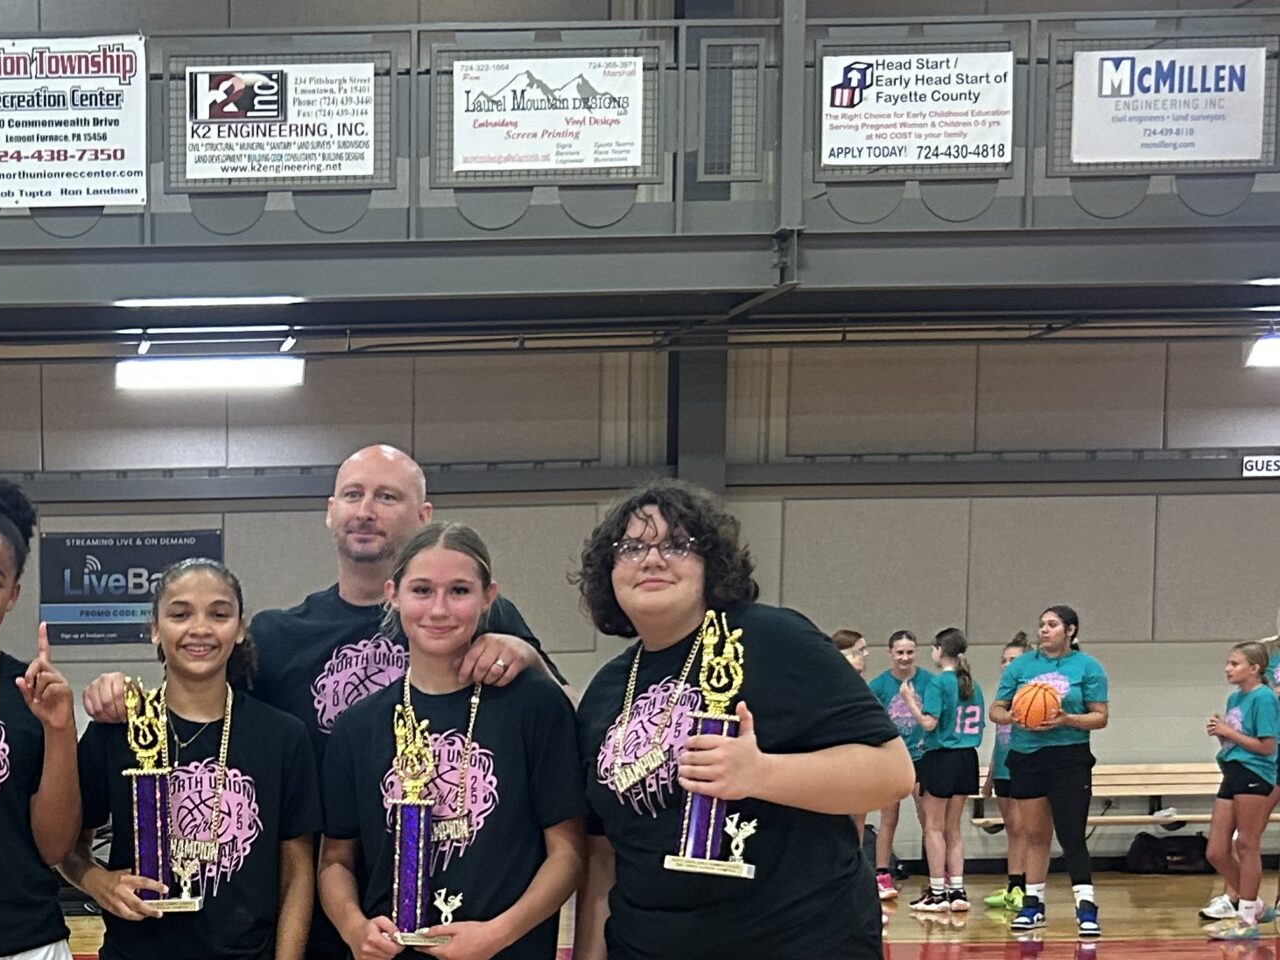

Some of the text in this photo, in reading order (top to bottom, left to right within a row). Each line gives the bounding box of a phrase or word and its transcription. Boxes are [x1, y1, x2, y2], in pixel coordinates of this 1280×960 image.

[33, 43, 136, 85] Township
[875, 57, 959, 71] Head Start /
[875, 71, 1009, 89] Early Head Start of
[70, 85, 124, 110] Center
[464, 89, 630, 113] Laurel Mountain DESIGNS
[876, 89, 981, 106] Fayette County
[1114, 99, 1225, 111] ENGINEERING INC
[825, 113, 839, 121] The
[840, 112, 862, 122] Right
[864, 112, 892, 120] Choice
[906, 111, 927, 120] Early
[928, 110, 969, 118] Childhood
[970, 109, 1011, 117] Education
[1128, 114, 1165, 124] engineers
[1172, 113, 1189, 121] land
[1190, 114, 1226, 123] surveyors
[13, 118, 90, 129] Commonwealth
[93, 117, 120, 128] Drive
[472, 116, 621, 130] Embroidery Vinyl Designs
[829, 123, 860, 132] Serving
[861, 122, 897, 131] Pregnant
[899, 121, 928, 129] Women
[938, 120, 972, 128] Children
[988, 120, 1001, 129] yrs
[5, 133, 35, 144] Lemont
[71, 133, 82, 142] PA
[83, 132, 108, 142] 15456
[190, 122, 369, 140] K2 ENGINEERING, INC.
[503, 128, 581, 140] Screen Printing
[875, 132, 888, 140] NO
[890, 132, 912, 140] COST
[924, 132, 942, 141] your
[943, 131, 968, 140] family
[828, 143, 1005, 160] APPLY TODAY! 724-430-4818
[220, 162, 342, 174] www.k2engineering.net
[60, 188, 83, 197] Ron
[86, 187, 138, 196] Landman
[65, 537, 114, 546] STREAMING
[116, 537, 133, 546] LIVE
[144, 537, 158, 545] ON
[160, 537, 196, 545] DEMAND
[63, 567, 163, 595] LiveBa
[80, 609, 139, 617] PROMO CODE:
[326, 652, 370, 679] NORTH
[954, 704, 981, 735] 12
[447, 748, 487, 774] UNON
[170, 775, 254, 801] ORTH UION
